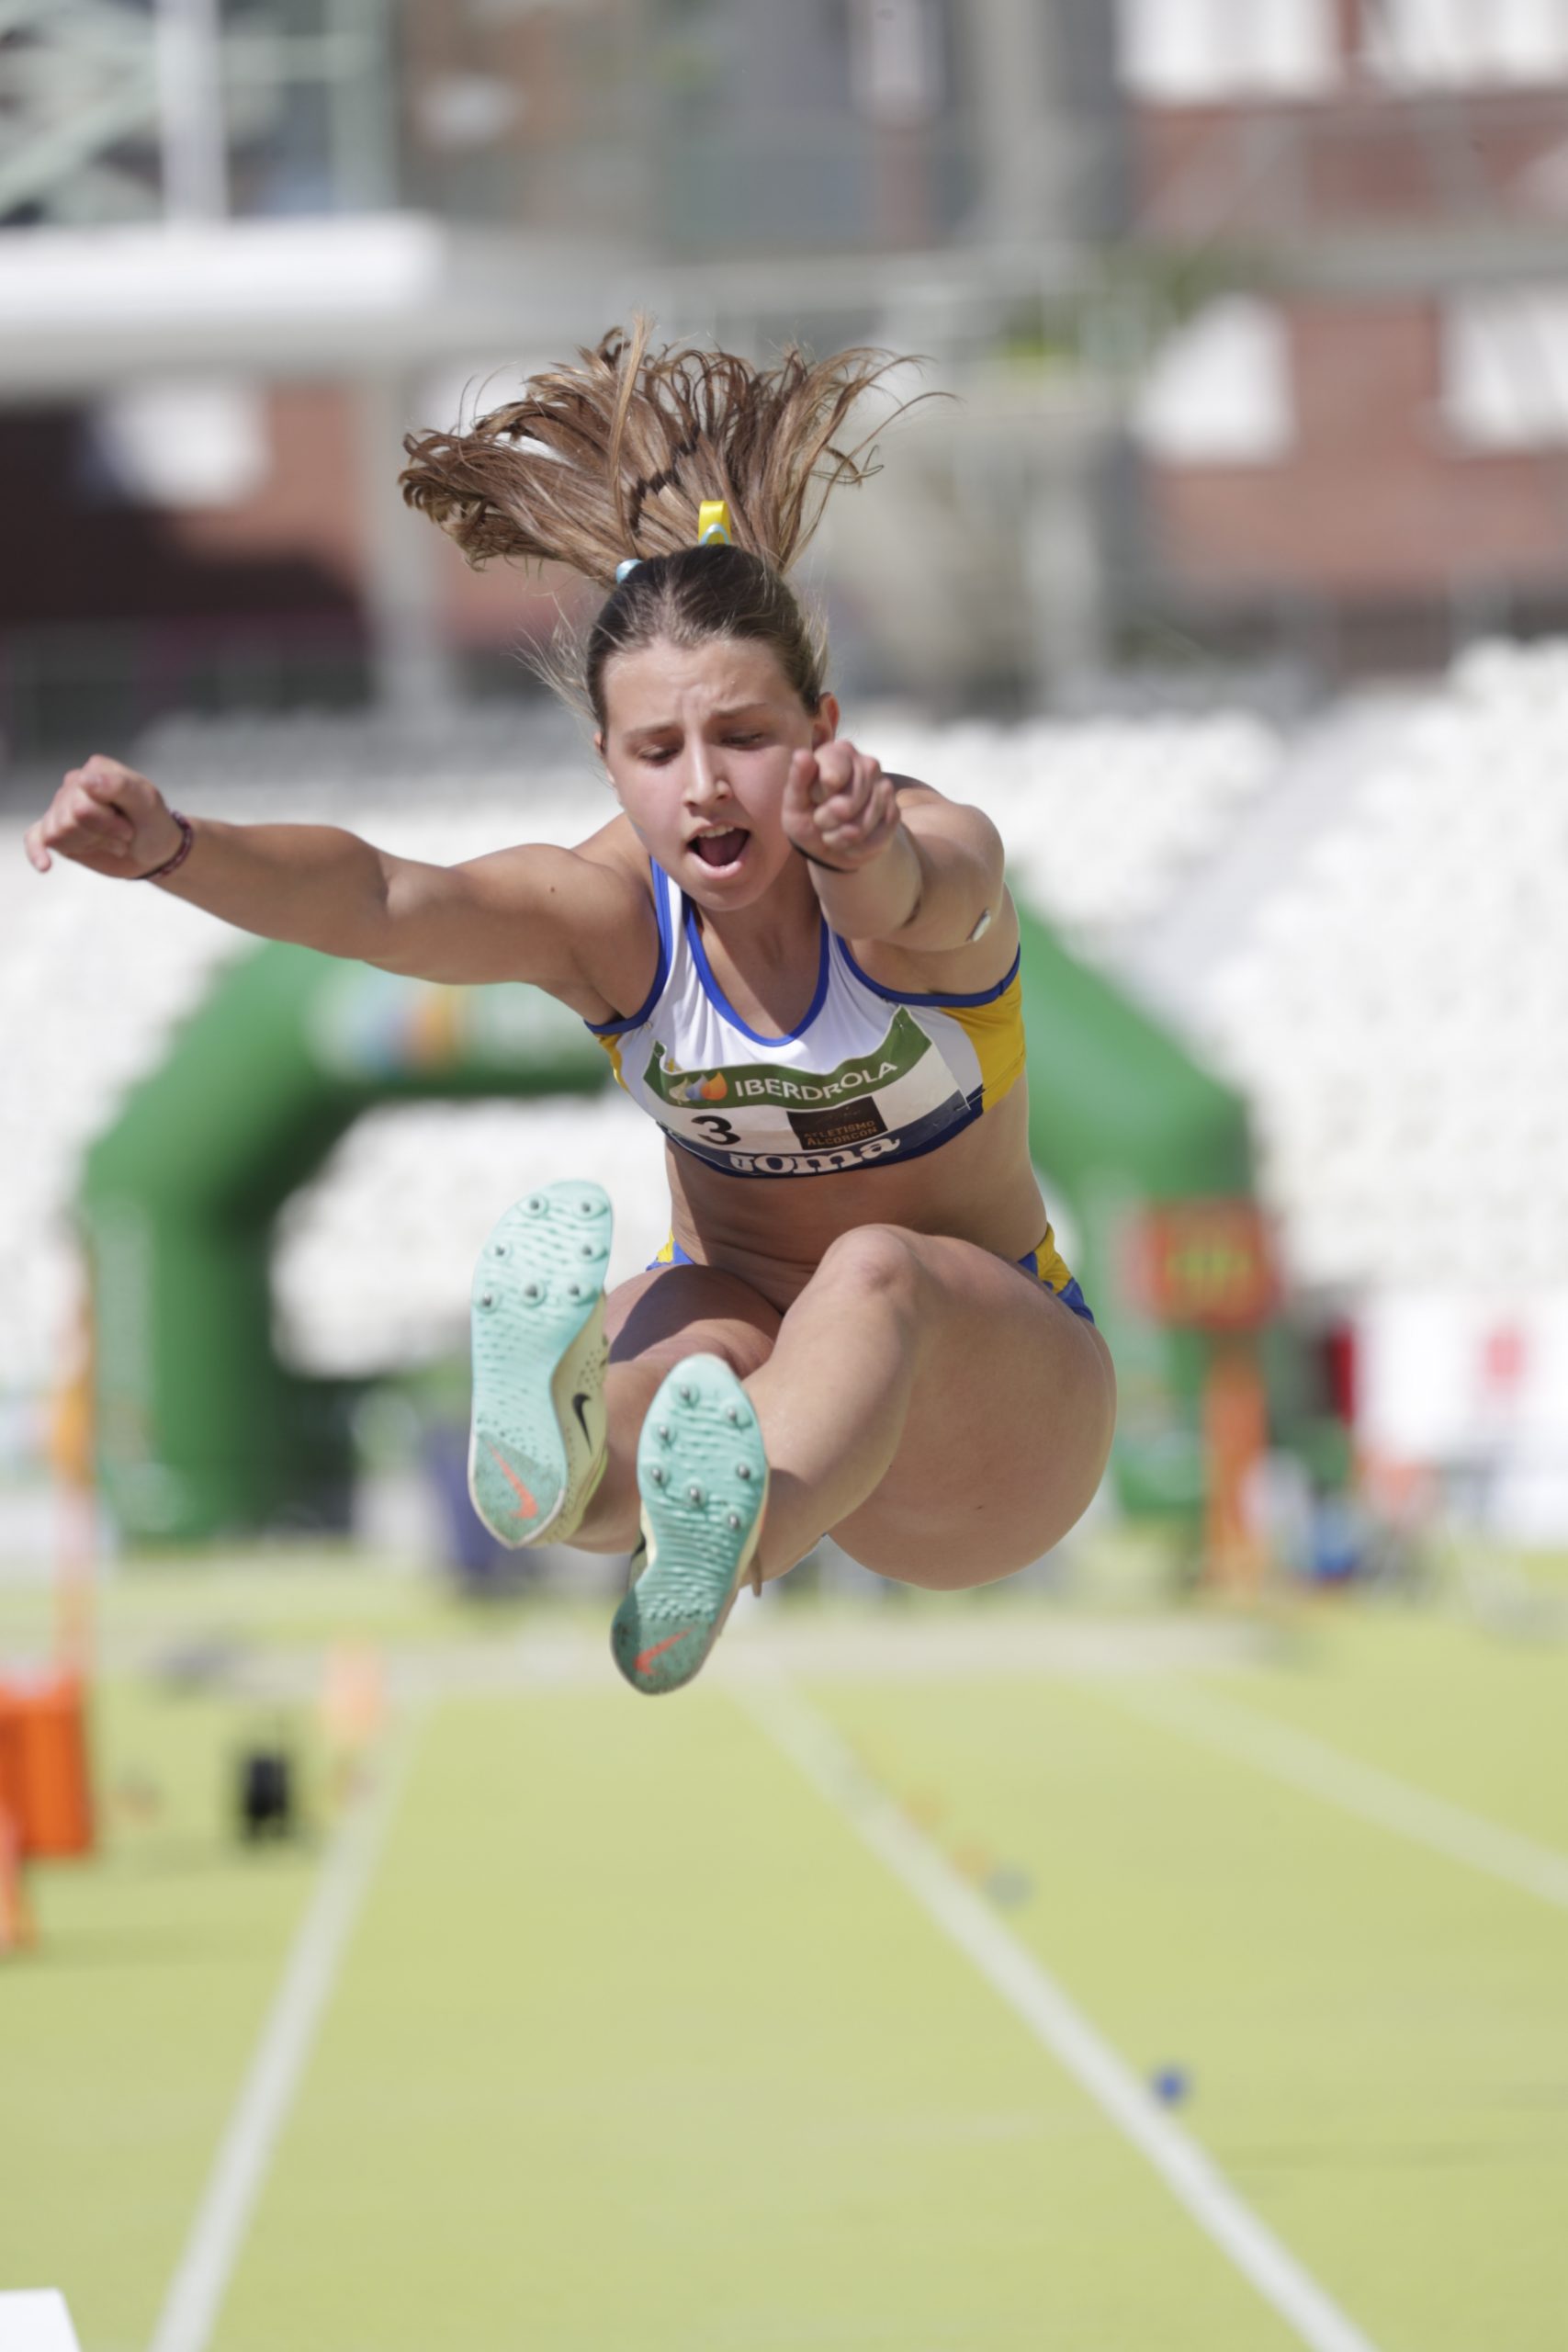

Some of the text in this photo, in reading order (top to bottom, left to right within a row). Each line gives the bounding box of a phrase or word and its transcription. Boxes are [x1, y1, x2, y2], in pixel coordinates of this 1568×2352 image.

[735, 1061, 897, 1102] IBERDROLA
[691, 1114, 741, 1146] 3
[803, 1120, 875, 1138] ATLETISMO
